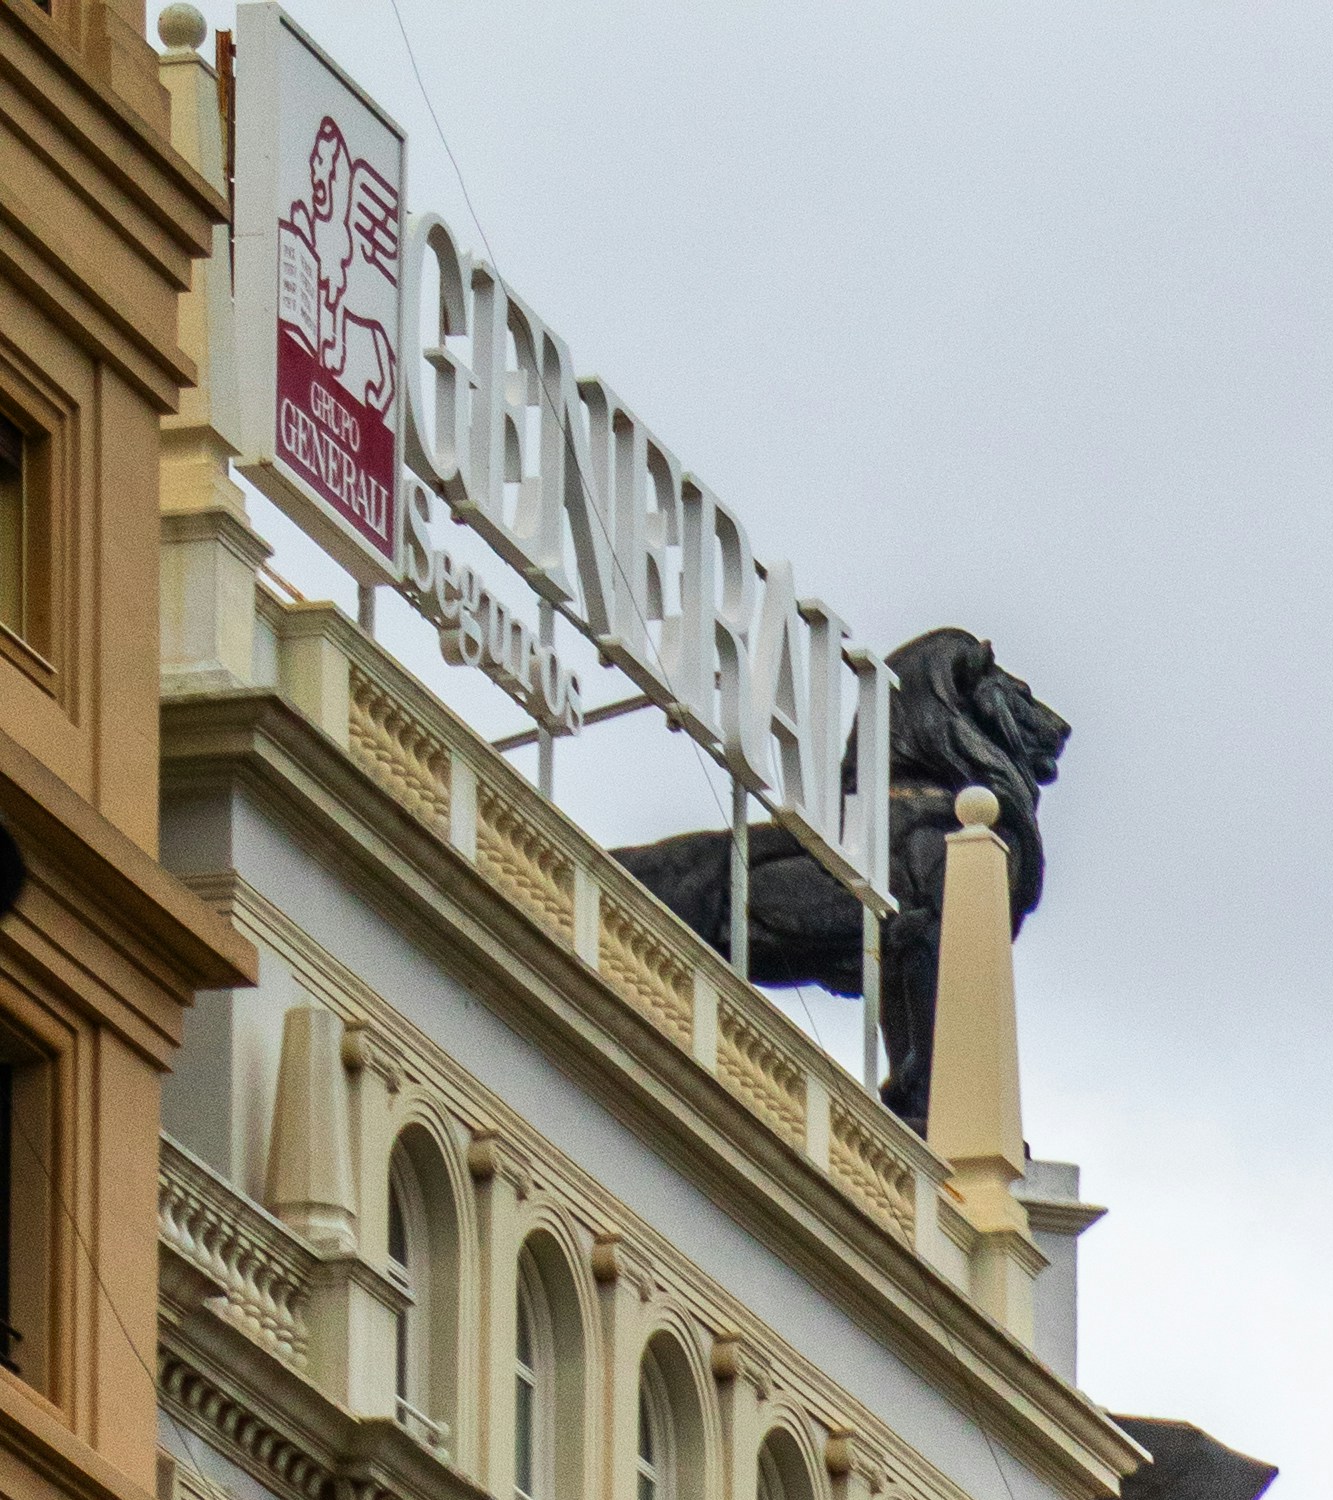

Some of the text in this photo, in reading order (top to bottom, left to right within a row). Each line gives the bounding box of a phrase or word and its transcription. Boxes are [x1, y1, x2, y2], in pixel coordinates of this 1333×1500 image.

[281, 397, 389, 541] GENERALI
[310, 380, 360, 452] GRUPO
[402, 479, 583, 737] Seguros
[405, 211, 900, 916] GENERALI
